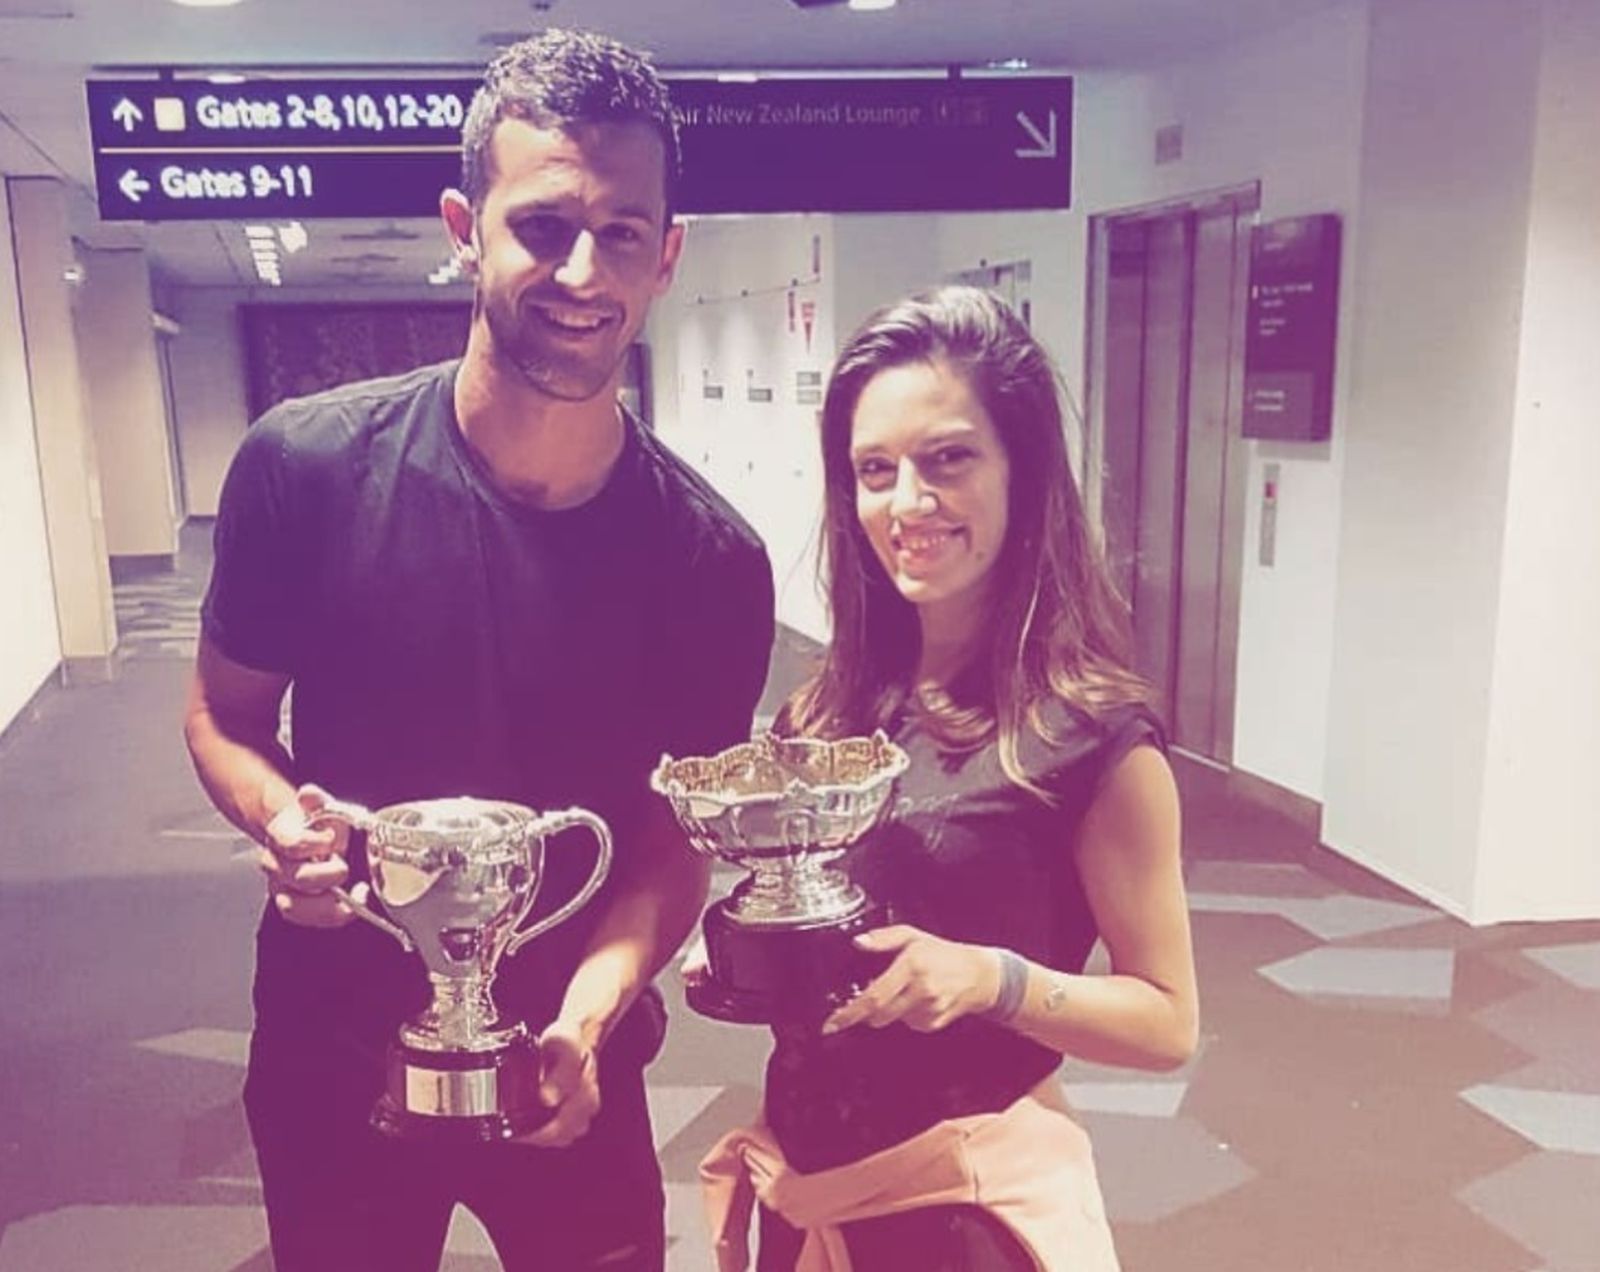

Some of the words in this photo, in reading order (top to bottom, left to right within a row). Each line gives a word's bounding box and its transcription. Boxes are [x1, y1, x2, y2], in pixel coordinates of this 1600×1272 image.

[196, 94, 282, 128] Gates
[706, 104, 752, 125] New
[758, 103, 839, 125] Zealand
[845, 105, 921, 128] Lounge
[160, 165, 247, 198] Gates
[250, 164, 313, 197] 9-11
